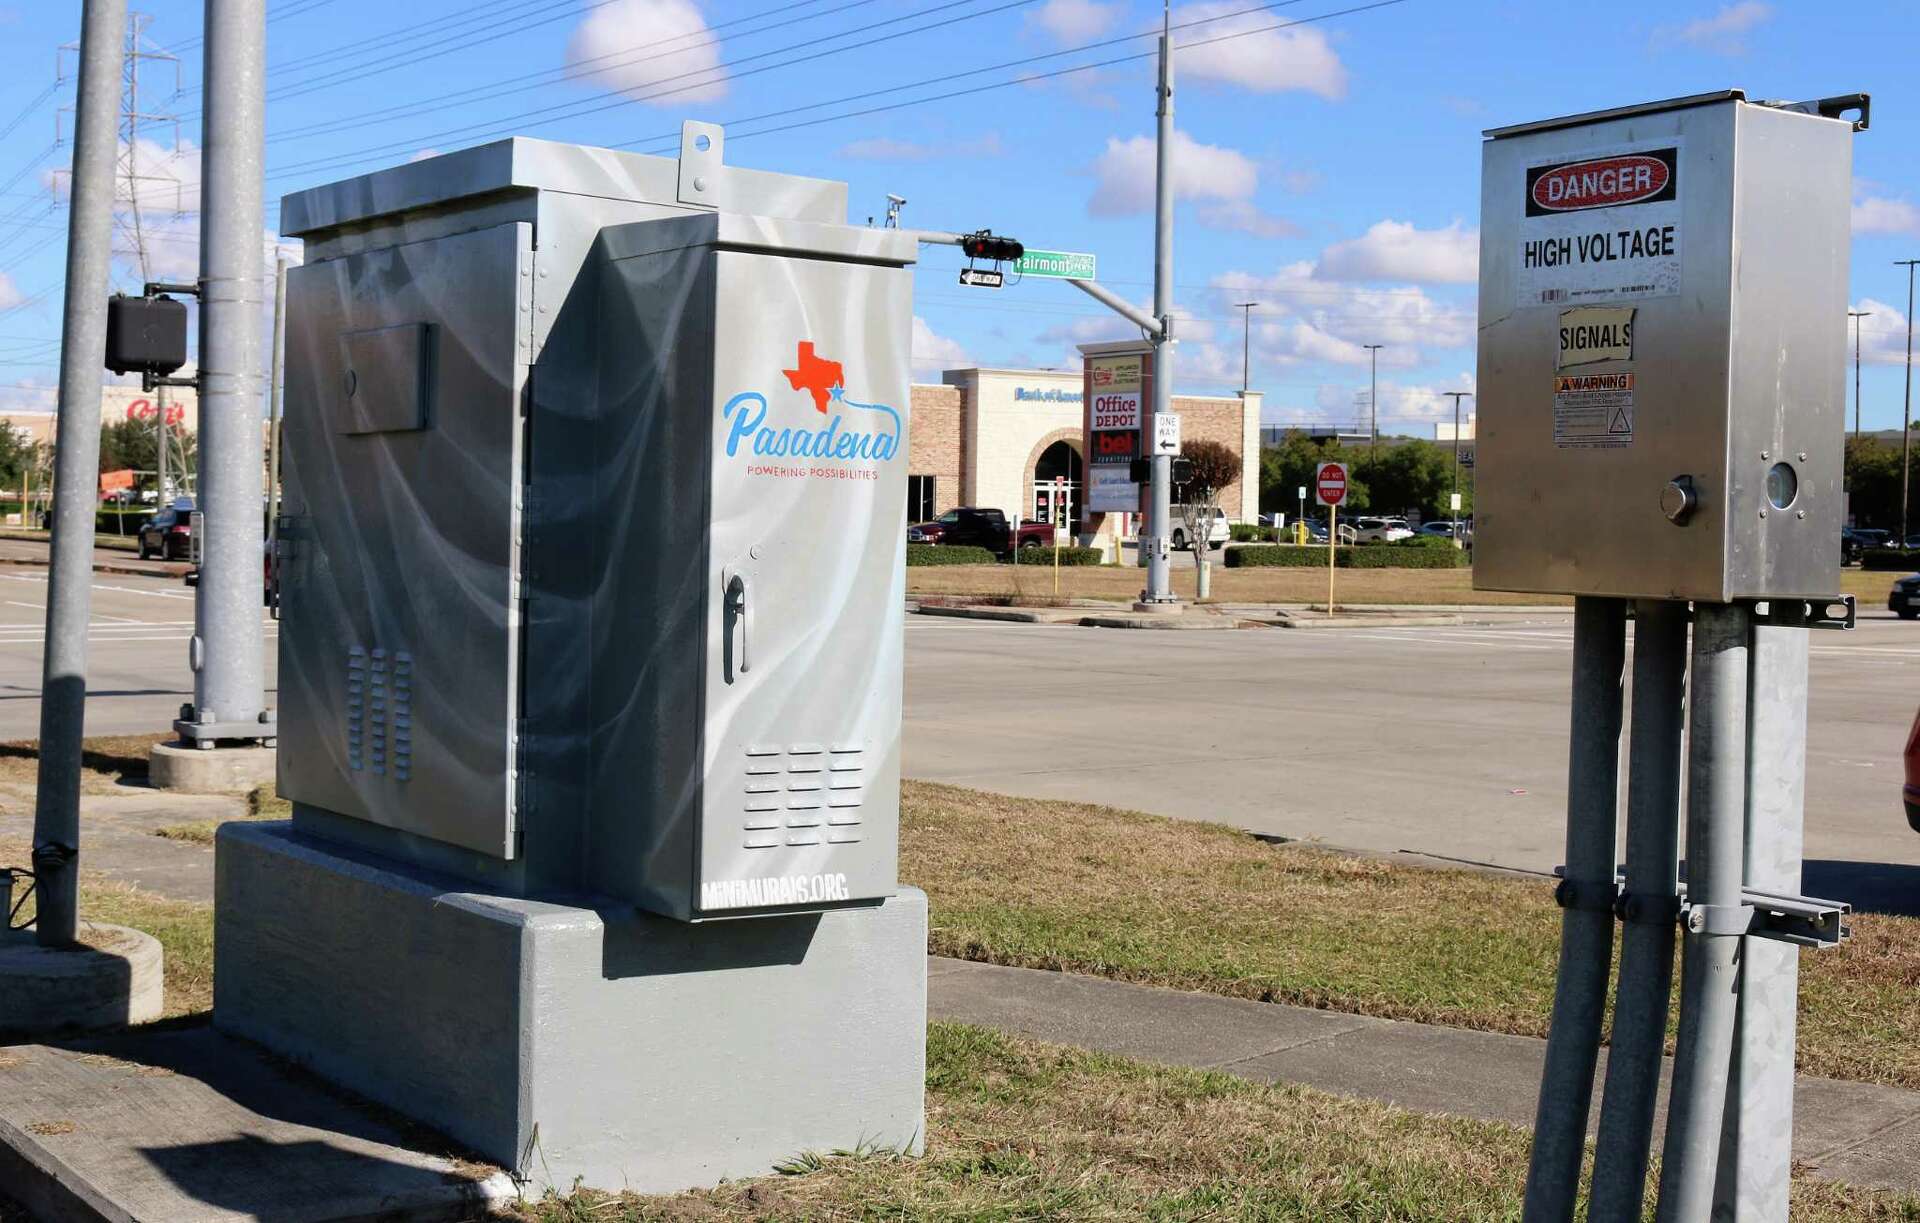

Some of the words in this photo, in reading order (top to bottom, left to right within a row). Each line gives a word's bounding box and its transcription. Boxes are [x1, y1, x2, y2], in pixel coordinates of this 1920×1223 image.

[1549, 165, 1651, 201] DANGER
[1525, 237, 1571, 268] HIGH
[1578, 226, 1674, 263] VOLTAGE
[1560, 324, 1630, 350] SIGNALS
[1571, 376, 1626, 390] WARNING
[1095, 396, 1136, 413] Office
[723, 392, 901, 461] Pasadena
[1096, 415, 1136, 427] DEPOT
[1160, 416, 1176, 426] ONE
[1160, 427, 1177, 436] WAY
[1099, 431, 1133, 454] bel
[747, 466, 806, 478] POWERING
[810, 467, 878, 480] POSSIBILITIES
[1322, 470, 1330, 479] DO
[1332, 470, 1343, 479] NOT
[1323, 490, 1340, 498] ENTER
